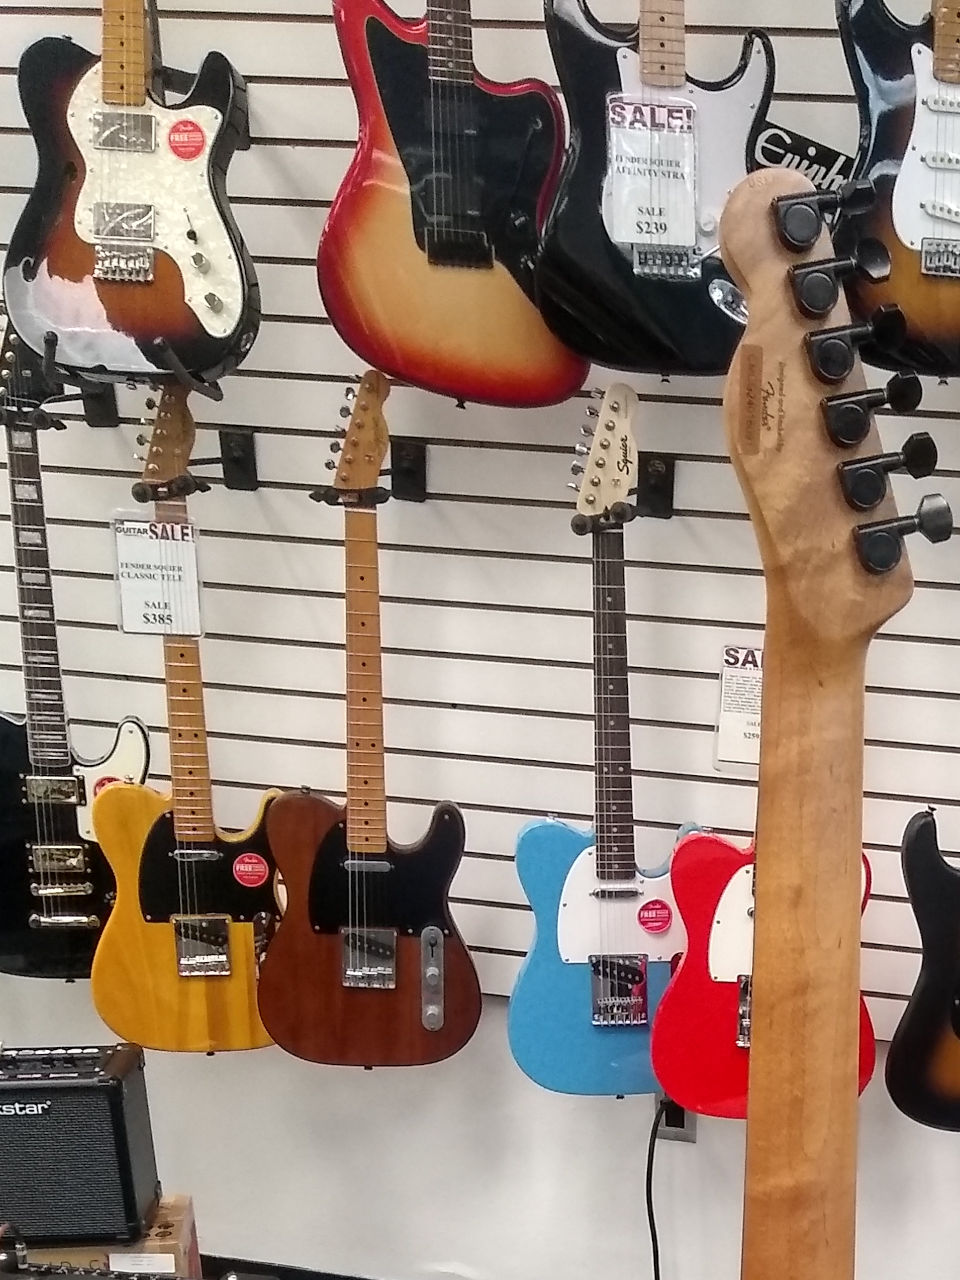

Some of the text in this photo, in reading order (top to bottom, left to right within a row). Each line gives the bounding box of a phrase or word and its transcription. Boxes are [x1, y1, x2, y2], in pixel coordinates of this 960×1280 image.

[610, 103, 693, 130] SALE!
[637, 207, 666, 217] SALE
[636, 221, 667, 235] $239
[617, 434, 633, 475] Squier
[115, 523, 195, 542] GUITAR SALE!
[121, 571, 159, 580] CLASSIC
[144, 600, 170, 610] SALE
[142, 612, 173, 625] $385
